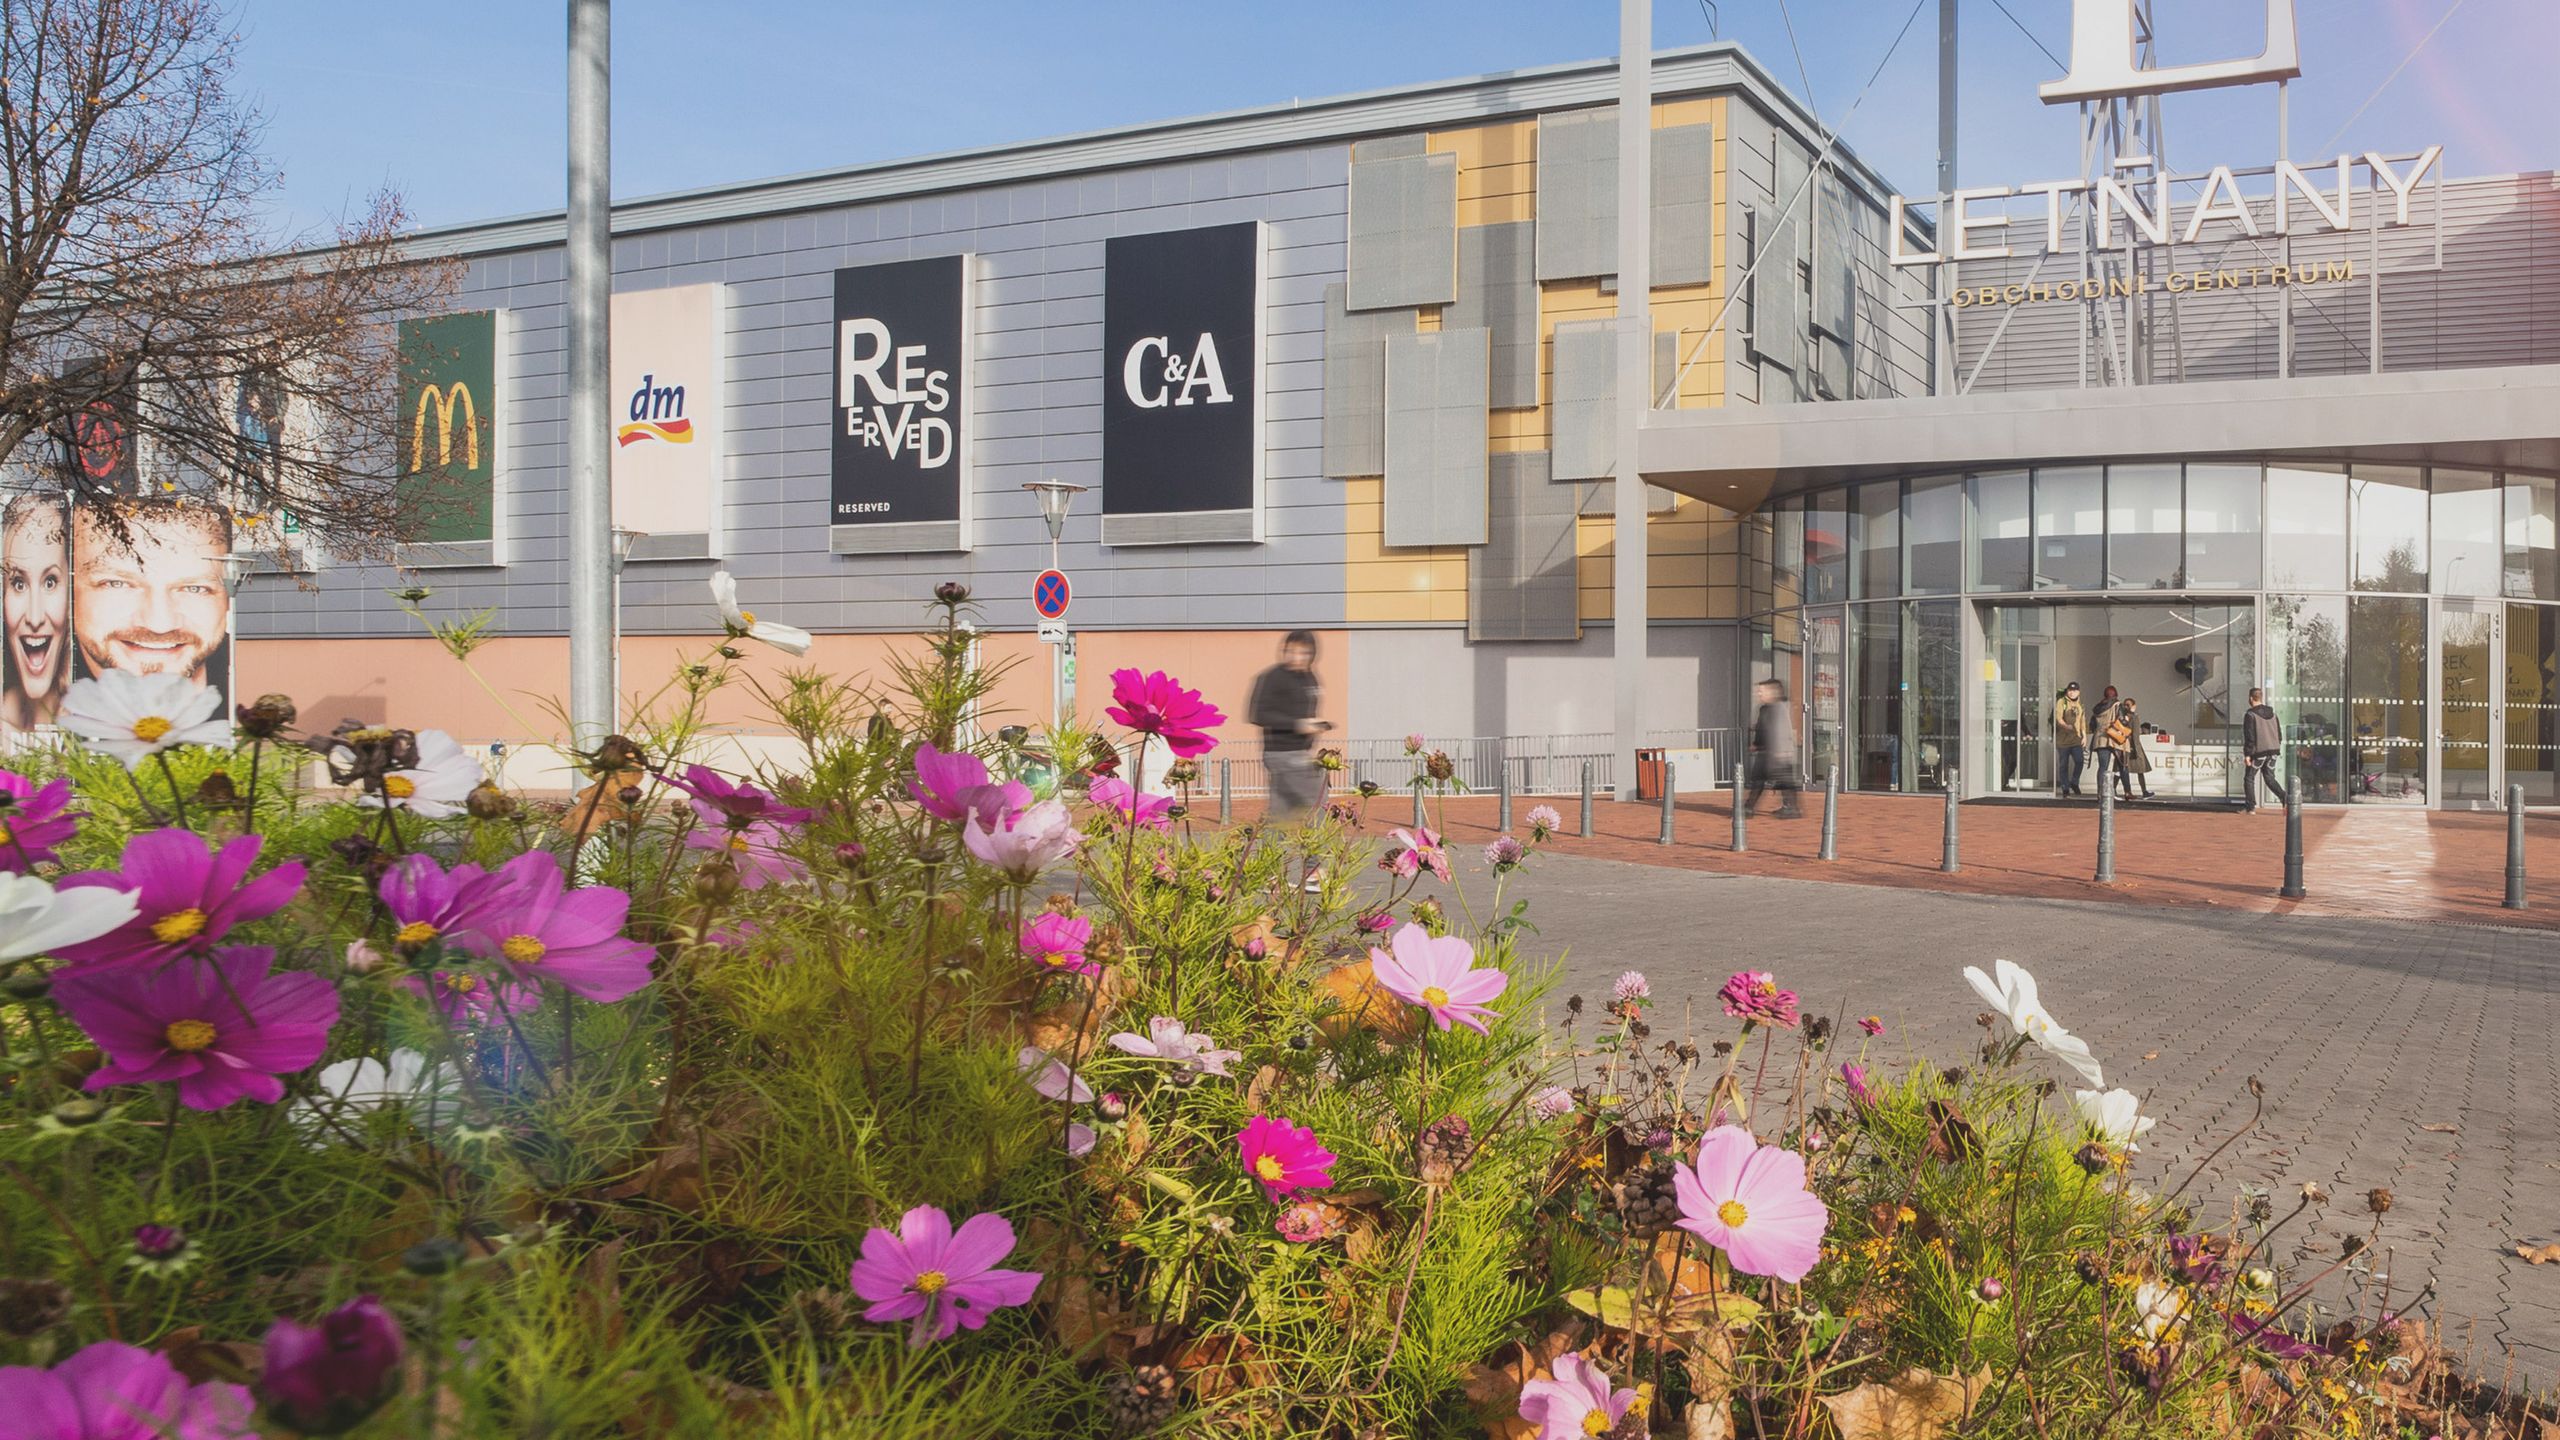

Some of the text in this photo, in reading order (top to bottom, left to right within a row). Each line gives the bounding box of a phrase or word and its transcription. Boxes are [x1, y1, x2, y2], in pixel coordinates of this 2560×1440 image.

[1952, 260, 2353, 307] OBCHODNÍ CENTRUM
[1123, 332, 1234, 408] C&A
[630, 374, 685, 422] dm
[838, 502, 891, 514] RESERVED
